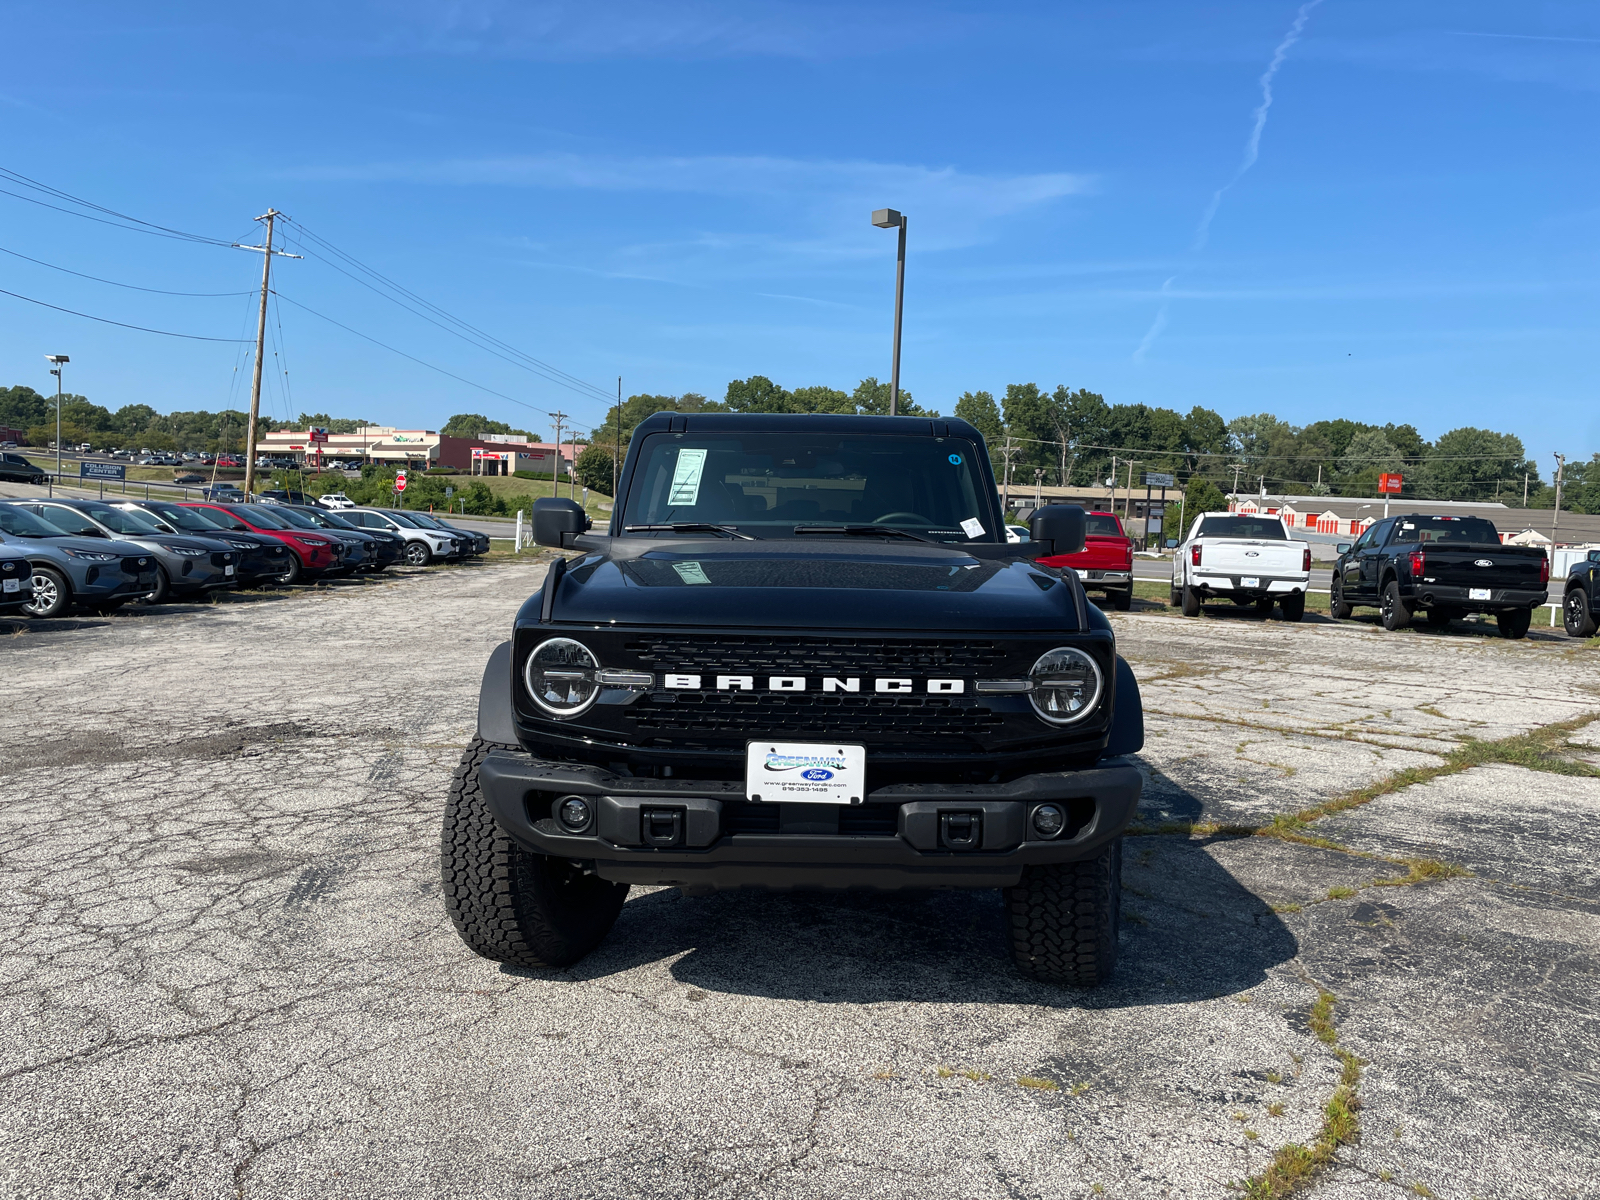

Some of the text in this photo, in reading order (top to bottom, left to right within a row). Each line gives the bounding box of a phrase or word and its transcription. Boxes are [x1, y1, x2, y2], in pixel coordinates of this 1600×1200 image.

[84, 463, 122, 471] COLLISION
[664, 673, 965, 694] BRONCO
[765, 753, 847, 768] GREENWAY
[806, 769, 828, 780] Ford
